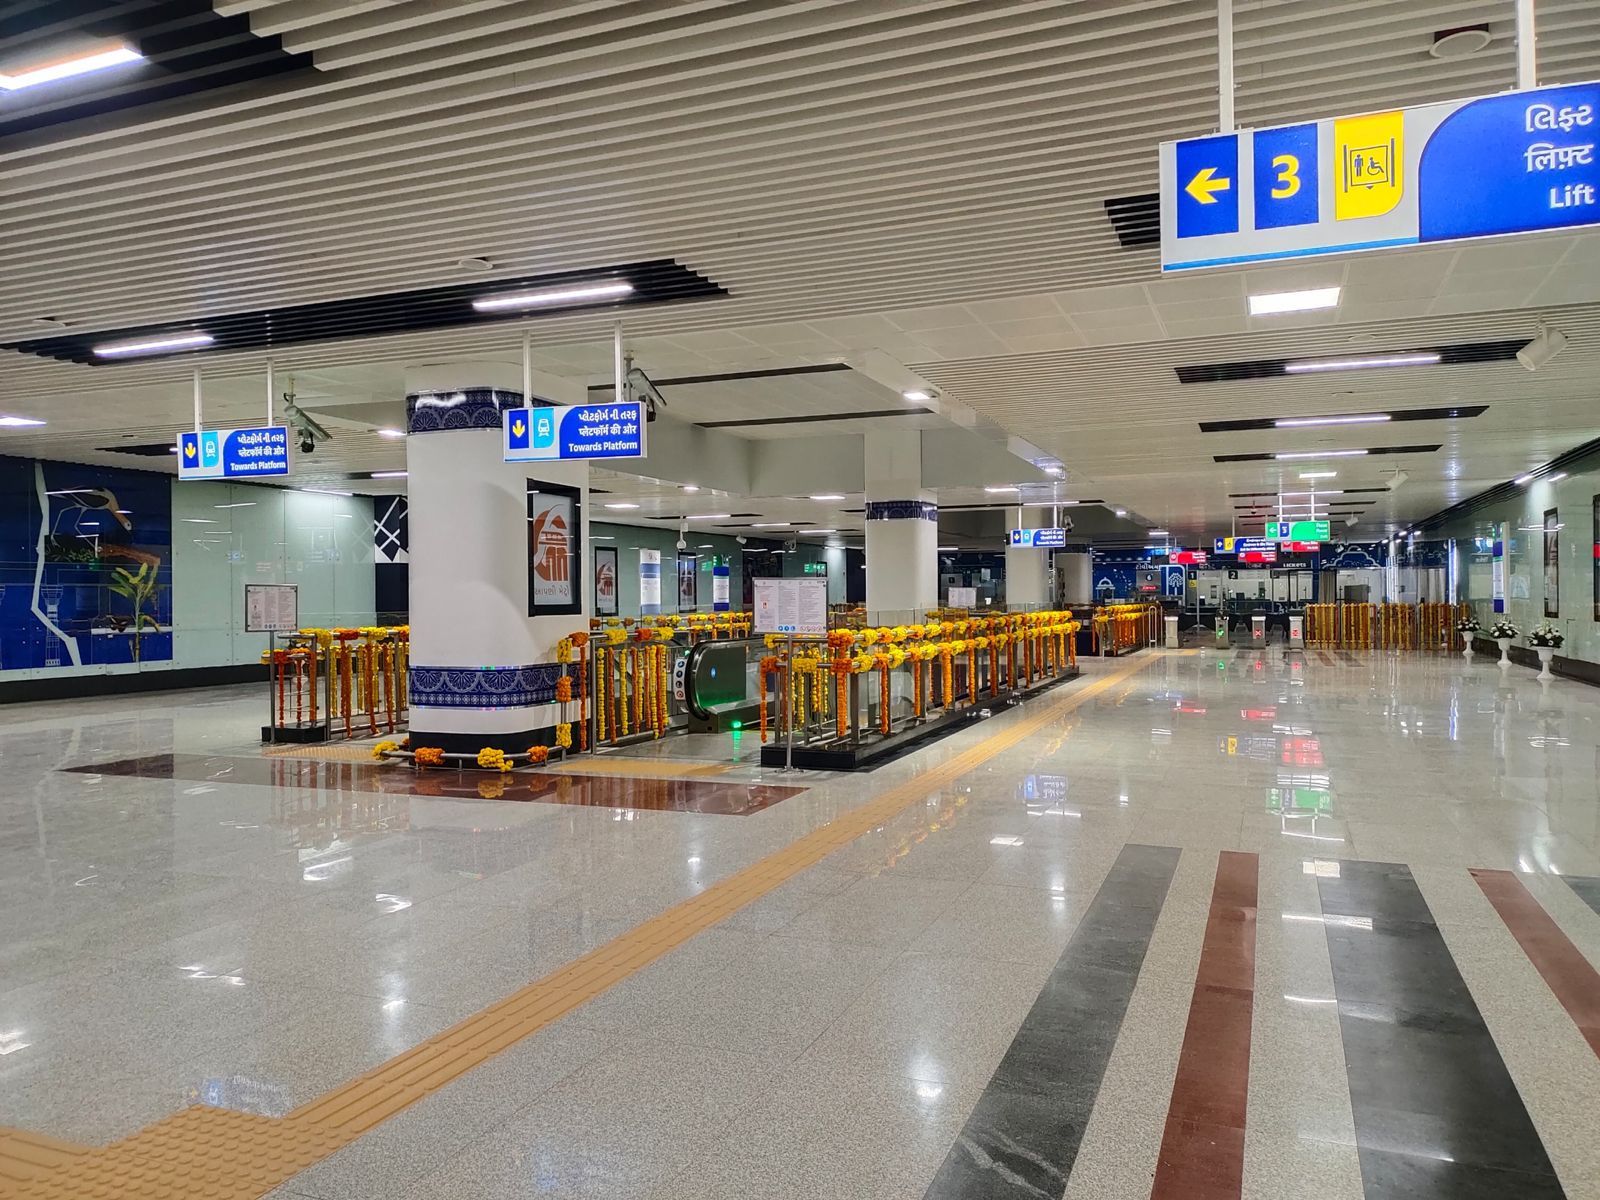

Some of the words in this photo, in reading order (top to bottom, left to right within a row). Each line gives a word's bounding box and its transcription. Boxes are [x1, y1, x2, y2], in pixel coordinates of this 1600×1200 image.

[1525, 104, 1593, 132] લિફ્ટ
[1270, 154, 1301, 199] 3
[1550, 184, 1595, 209] Lift
[610, 409, 620, 420] ની
[621, 410, 637, 421] તરફ
[578, 424, 609, 436] प्लेटफॉर्म
[610, 423, 621, 435] की
[622, 423, 638, 434] ओर
[263, 445, 272, 456] की
[568, 442, 602, 452] Towards
[603, 440, 638, 450] Platform
[230, 461, 258, 471] Towards
[258, 460, 286, 470] Platform
